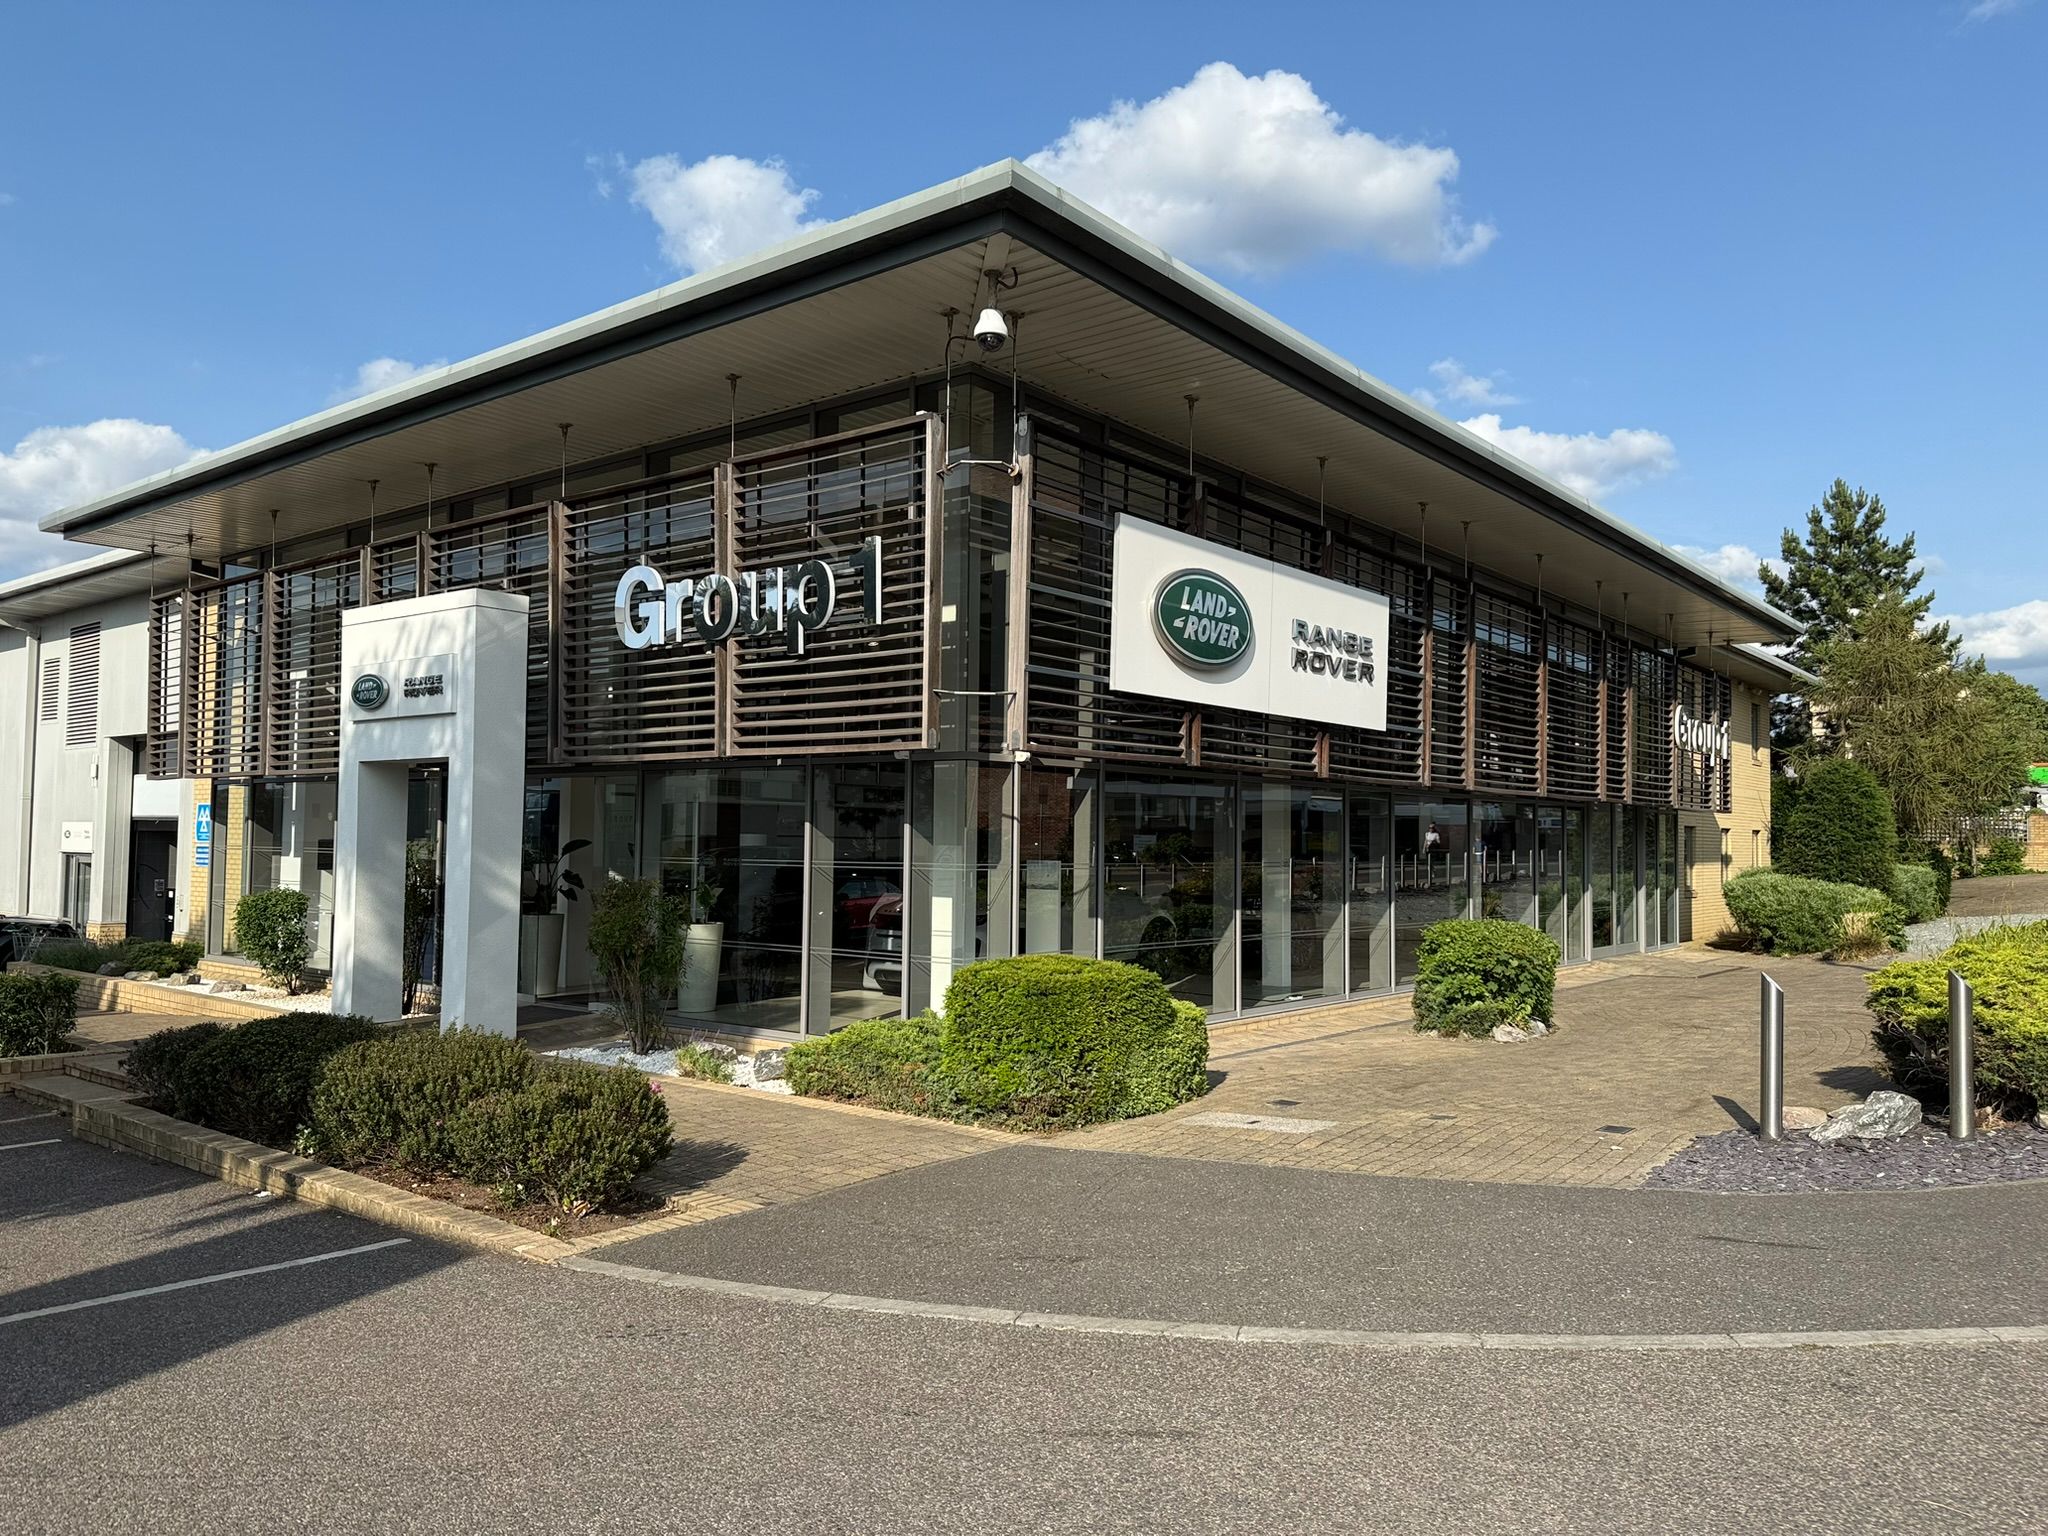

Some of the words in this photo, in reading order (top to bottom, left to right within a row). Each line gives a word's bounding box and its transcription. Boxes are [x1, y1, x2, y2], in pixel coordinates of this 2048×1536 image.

[615, 559, 835, 655] Group
[849, 535, 882, 625] 1
[1183, 615, 1239, 649] ROVER
[1292, 618, 1373, 659] RANGE
[404, 674, 443, 687] RANGE
[1292, 647, 1375, 686] ROVER
[404, 686, 444, 698] ROVER
